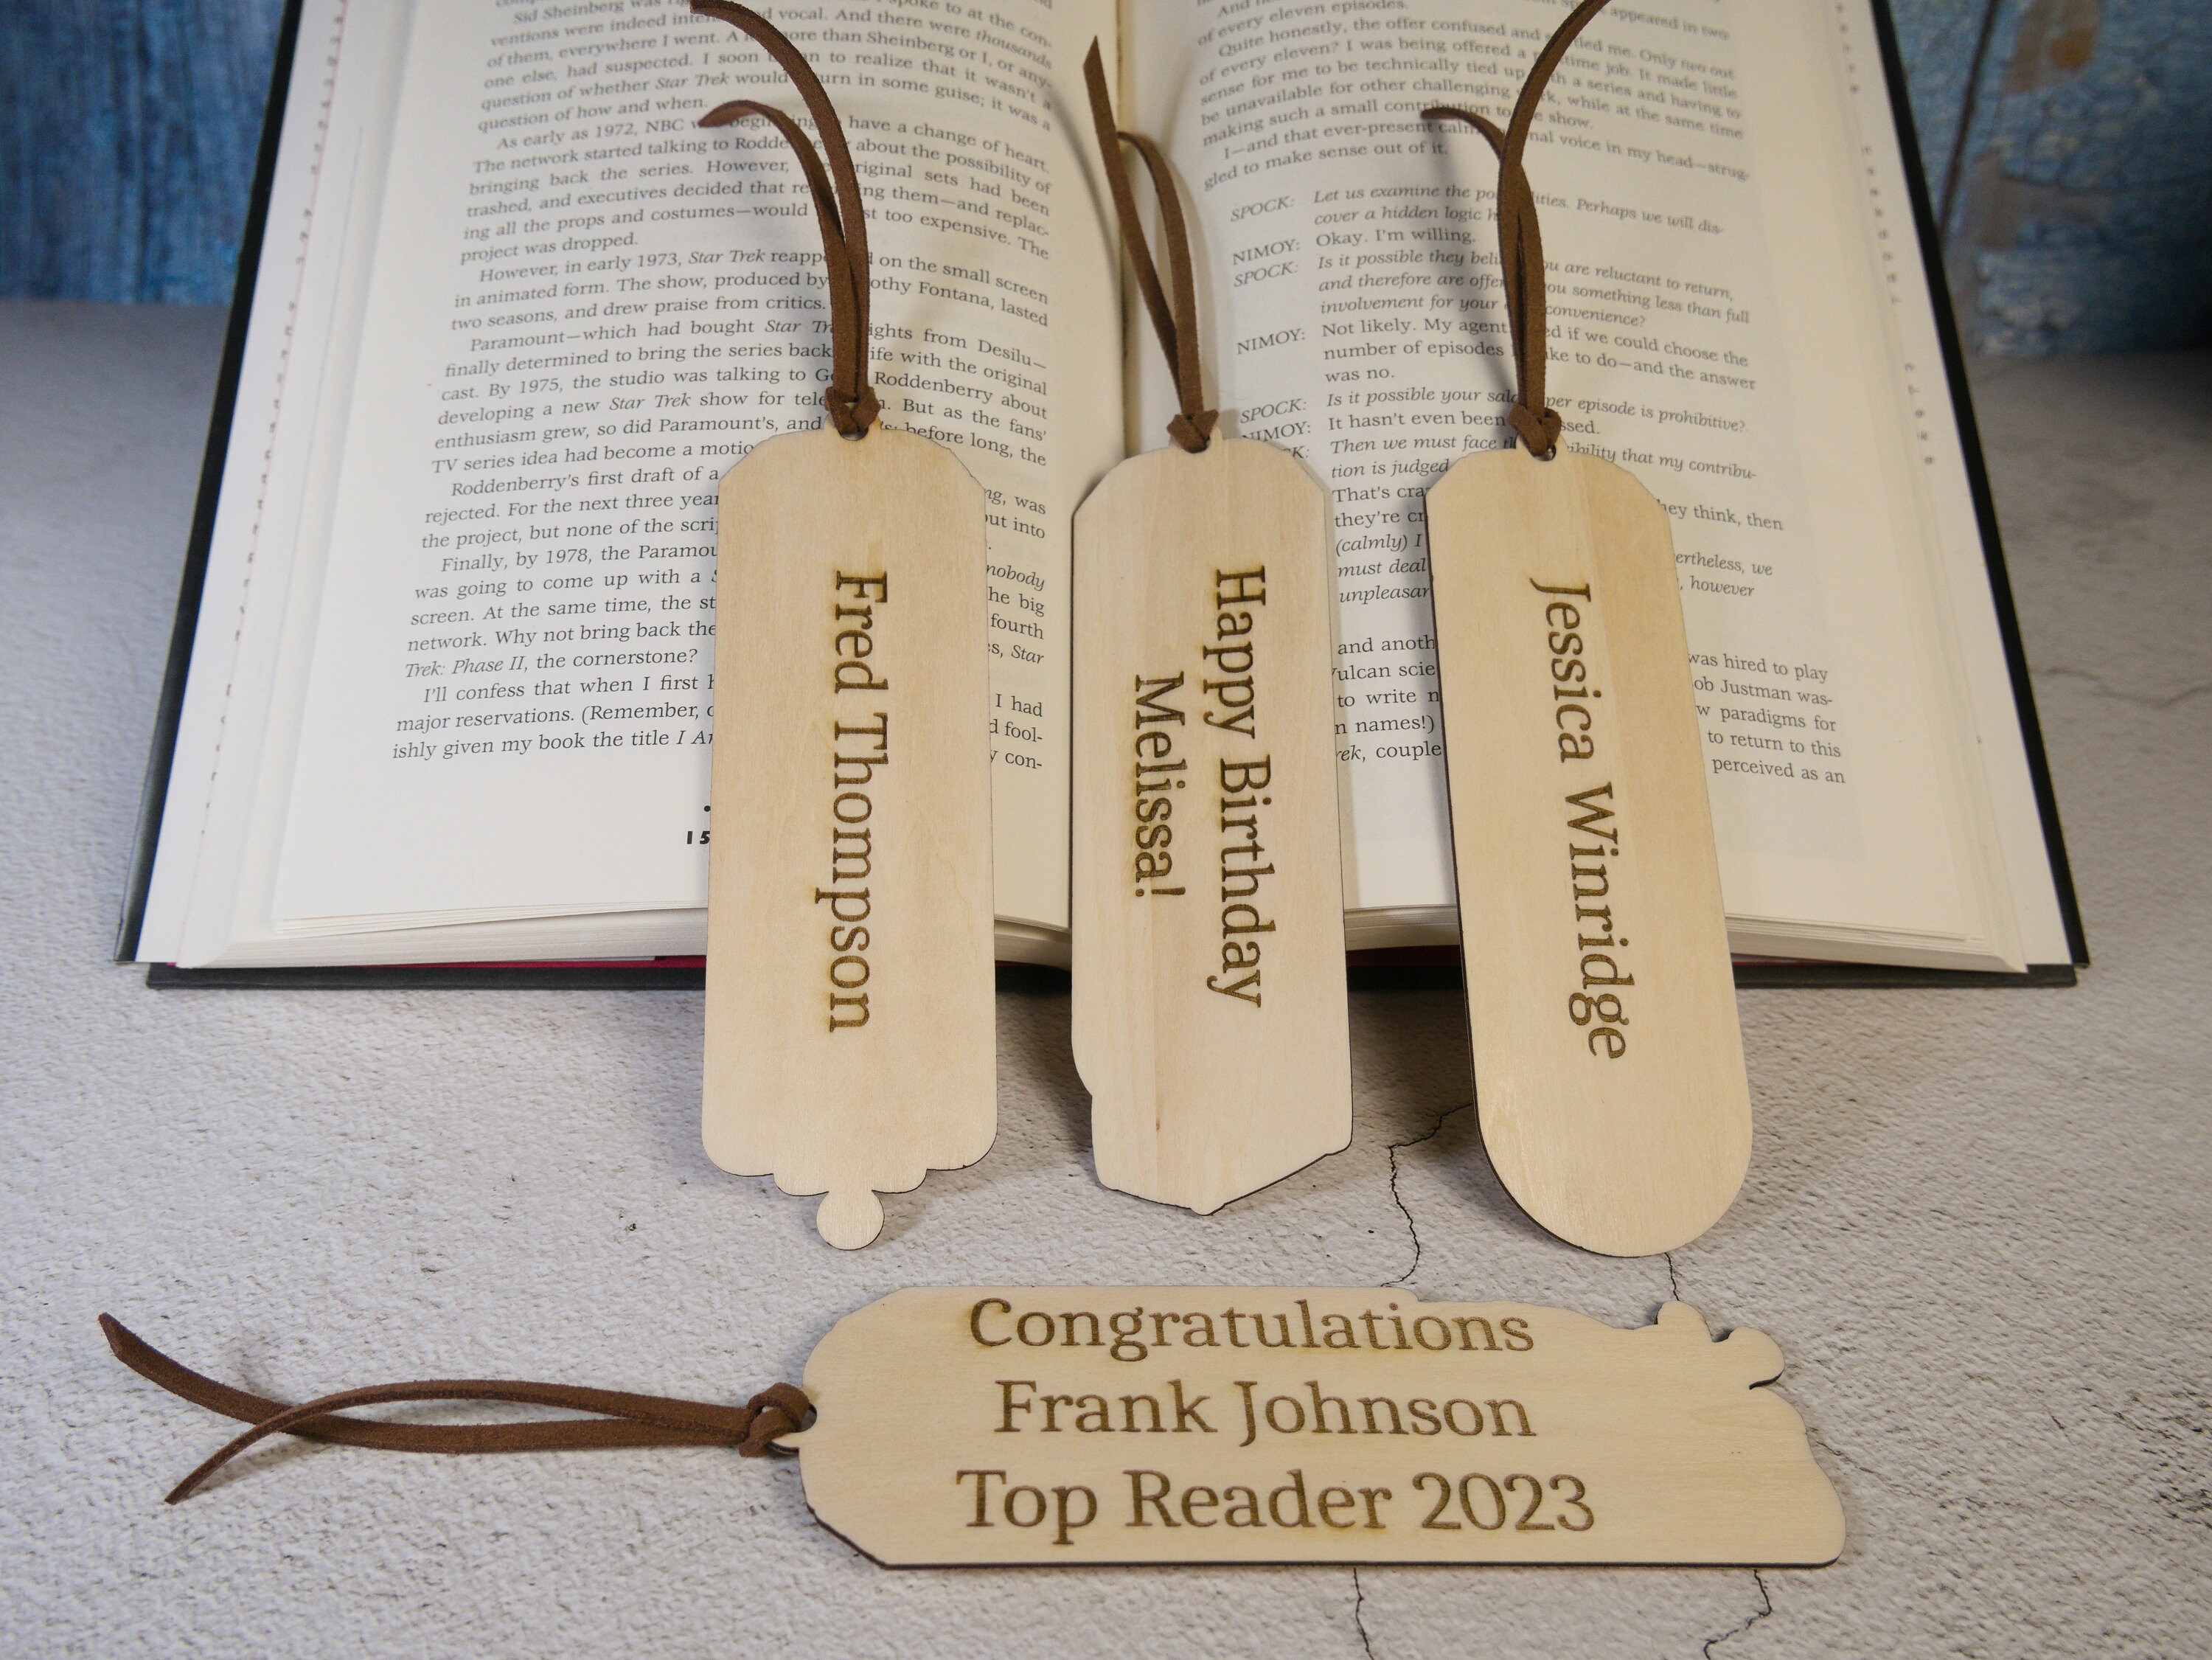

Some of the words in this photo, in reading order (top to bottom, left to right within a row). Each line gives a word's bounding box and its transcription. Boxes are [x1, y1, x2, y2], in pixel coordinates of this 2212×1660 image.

[577, 188, 667, 205] executives
[1231, 196, 1295, 221] SPOCK:
[1371, 184, 1441, 198] examine
[1577, 198, 1636, 220] Perhaps
[1382, 205, 1438, 218] hidden
[461, 246, 518, 265] project
[562, 232, 638, 251] dropped.
[920, 216, 1010, 245] expensive.
[1233, 239, 1299, 265] NIMOY:
[1316, 232, 1367, 246] Okay.
[1411, 226, 1475, 245] willing.
[480, 265, 557, 282] However,
[587, 256, 631, 272] early
[639, 253, 681, 267] 1973,
[1234, 262, 1298, 287] SPOCK:
[1356, 249, 1423, 268] possible
[1596, 265, 1660, 286] reluctant
[1686, 283, 1732, 301] return,
[476, 284, 557, 305] animated
[563, 282, 608, 296] form.
[657, 275, 706, 289] show,
[919, 281, 994, 310] Fontana,
[1359, 272, 1430, 289] therefore
[1573, 287, 1650, 310] something
[487, 311, 557, 327] seasons,
[1321, 296, 1424, 314] involvement
[1545, 305, 1645, 326] convenience?
[922, 328, 967, 348] from
[1237, 328, 1304, 355] NIMOY:
[1321, 323, 1354, 336] Not
[1360, 318, 1416, 334] likely.
[1614, 336, 1658, 353] could
[1664, 341, 1717, 361] choose
[507, 350, 608, 371] determined
[639, 347, 686, 362] bring
[984, 368, 1046, 396] original
[1324, 342, 1397, 360] number
[1427, 341, 1503, 358] episodes
[1700, 372, 1755, 389] answer
[1366, 369, 1394, 379] no.
[520, 378, 563, 393] 1975,
[609, 370, 664, 386] studio
[874, 372, 993, 404] Roddenberry
[438, 407, 534, 425] developing
[609, 397, 645, 410] Star
[655, 392, 691, 408] Trek
[1240, 398, 1305, 423] SPOCK:
[1365, 386, 1435, 406] possible
[1441, 391, 1481, 404] your
[1578, 400, 1635, 415] episode
[1658, 410, 1745, 431] prohibitive?
[1348, 413, 1405, 428] hasn't
[432, 459, 458, 473] TV
[464, 457, 515, 470] series
[521, 451, 557, 465] idea
[604, 445, 675, 459] become
[435, 431, 535, 448] enthusiasm
[543, 427, 588, 443] grew,
[970, 432, 1012, 459] long,
[1330, 439, 1376, 454] Then
[1413, 437, 1457, 448] must
[1689, 461, 1756, 479] contribu-
[451, 474, 579, 496] Roddenberry's
[588, 471, 624, 485] first
[631, 468, 675, 483] draft
[425, 504, 499, 526] rejected.
[508, 502, 538, 516] For
[625, 493, 673, 508] three
[1332, 486, 1390, 502] That's
[1694, 504, 1740, 526] think,
[1747, 513, 1783, 530] then
[1335, 510, 1400, 528] they're
[456, 529, 521, 549] project,
[530, 525, 560, 539] but
[1336, 534, 1408, 556] (calmly)
[441, 554, 507, 572] Finally,
[546, 549, 591, 564] 1978,
[1338, 562, 1382, 577] must
[1389, 558, 1426, 573] deal
[1690, 575, 1755, 596] however
[456, 583, 507, 600] going
[637, 569, 681, 584] with
[408, 632, 487, 651] network.
[495, 629, 538, 647] Why
[580, 625, 630, 642] bring
[636, 621, 681, 637] back
[411, 611, 474, 625] screen.
[548, 602, 596, 615] same
[605, 597, 650, 614] time,
[990, 613, 1044, 639] fourth
[835, 570, 888, 694] Fred
[406, 661, 445, 678] Trek:
[451, 659, 504, 674] Phase
[573, 649, 698, 667] cornerstone?
[1203, 566, 1266, 739] Happy
[1338, 637, 1374, 654] and
[1722, 653, 1767, 673] hired
[1794, 664, 1828, 684] play
[423, 687, 447, 702] I'll
[456, 683, 524, 701] confess
[580, 677, 633, 693] when
[659, 675, 698, 690] first
[1720, 679, 1792, 701] Justman
[397, 715, 451, 732] major
[456, 709, 574, 727] reservations.
[582, 702, 698, 725] (Remember,
[1004, 721, 1043, 743] fool-
[1365, 689, 1416, 704] write
[1719, 708, 1806, 729] paradigms
[1814, 715, 1836, 732] for
[442, 742, 494, 759] given
[538, 732, 585, 749] book
[631, 729, 669, 746] title
[1005, 753, 1042, 769] con-
[1354, 715, 1435, 733] names!)
[1730, 735, 1784, 751] return
[1811, 740, 1841, 757] this
[1376, 741, 1441, 760] couple
[1711, 759, 1795, 777] perceived
[1135, 671, 1187, 897] Melissa!
[1529, 577, 1601, 763] Jessica
[1565, 782, 1635, 1058] Winridge
[815, 712, 888, 1032] Thompson
[1207, 754, 1276, 1007] Birthday
[970, 1297, 1534, 1362] Congratulations
[995, 1379, 1217, 1433] Frank
[1234, 1381, 1537, 1447] Johnson
[956, 1470, 1097, 1546] Top
[1123, 1469, 1392, 1529] Reader
[1413, 1473, 1594, 1531] 2023
